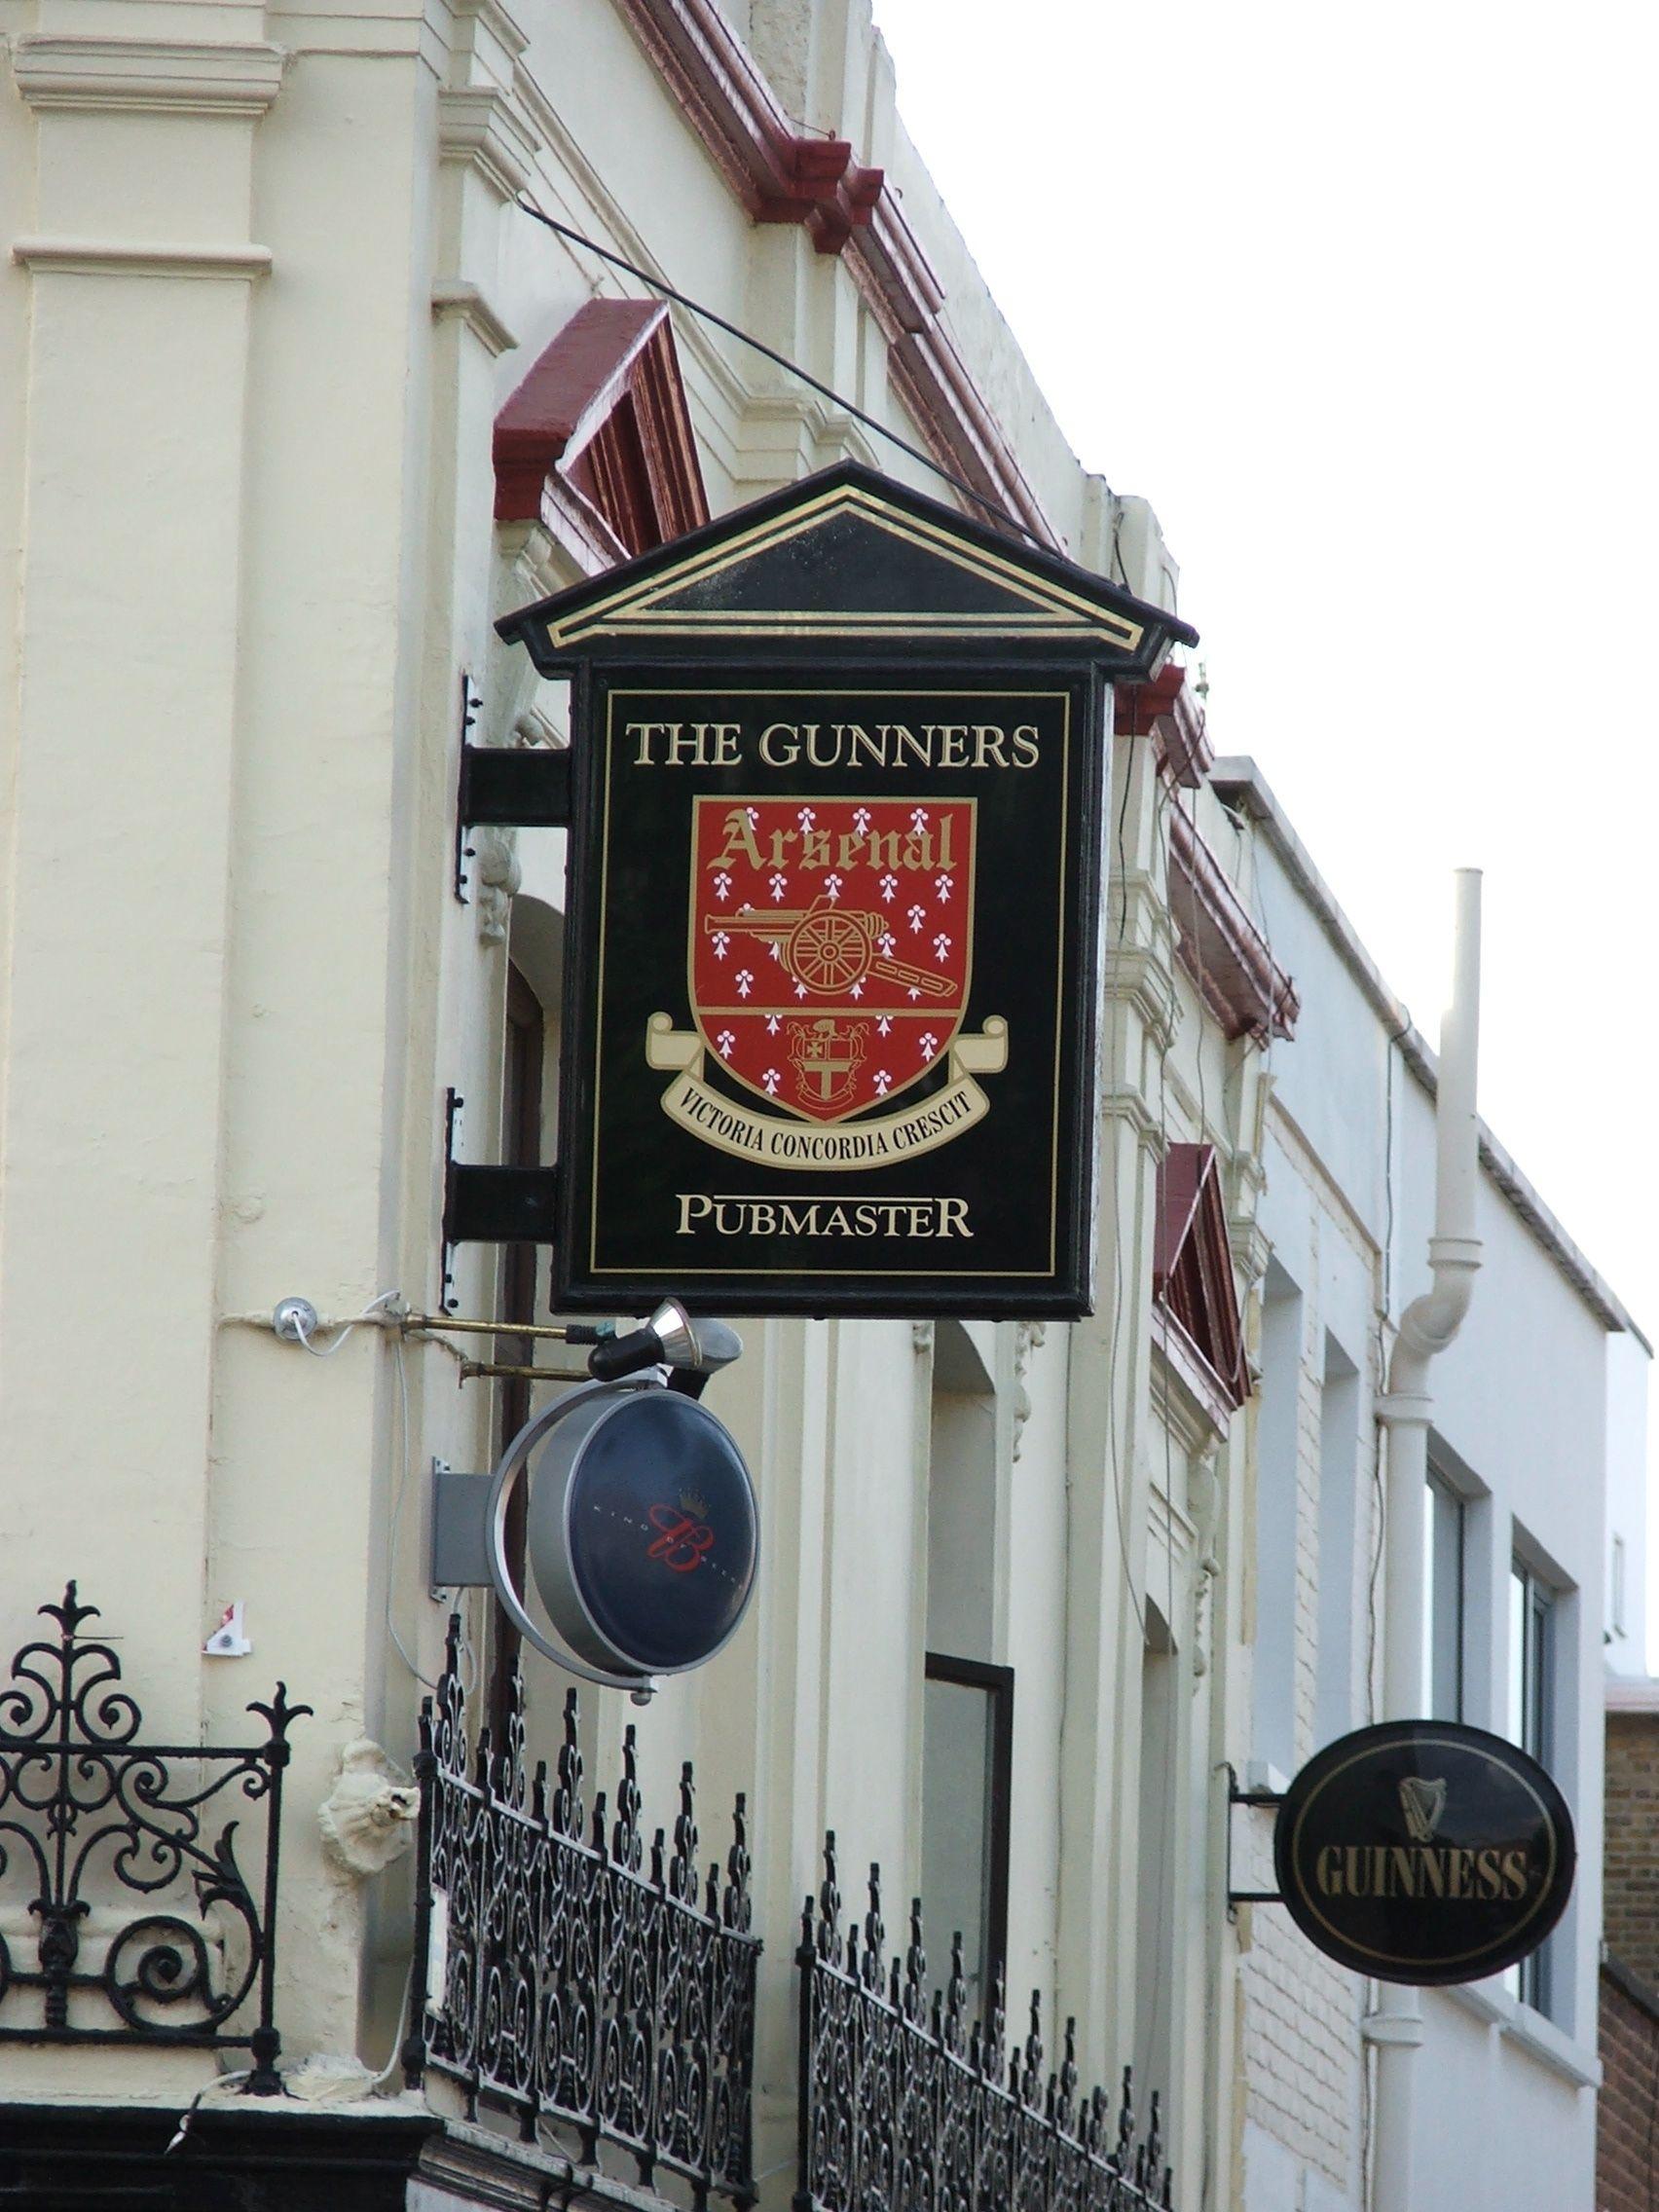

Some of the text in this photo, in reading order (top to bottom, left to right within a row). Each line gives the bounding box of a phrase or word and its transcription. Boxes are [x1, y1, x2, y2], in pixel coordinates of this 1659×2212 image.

[625, 722, 1040, 768] THE GUNNERS
[706, 807, 958, 872] Arsenal
[680, 1086, 974, 1161] VICTORIA CONCORDIA CRESCIT
[675, 1192, 974, 1238] PUBMASTER
[1316, 1845, 1528, 1899] GUINNESS
